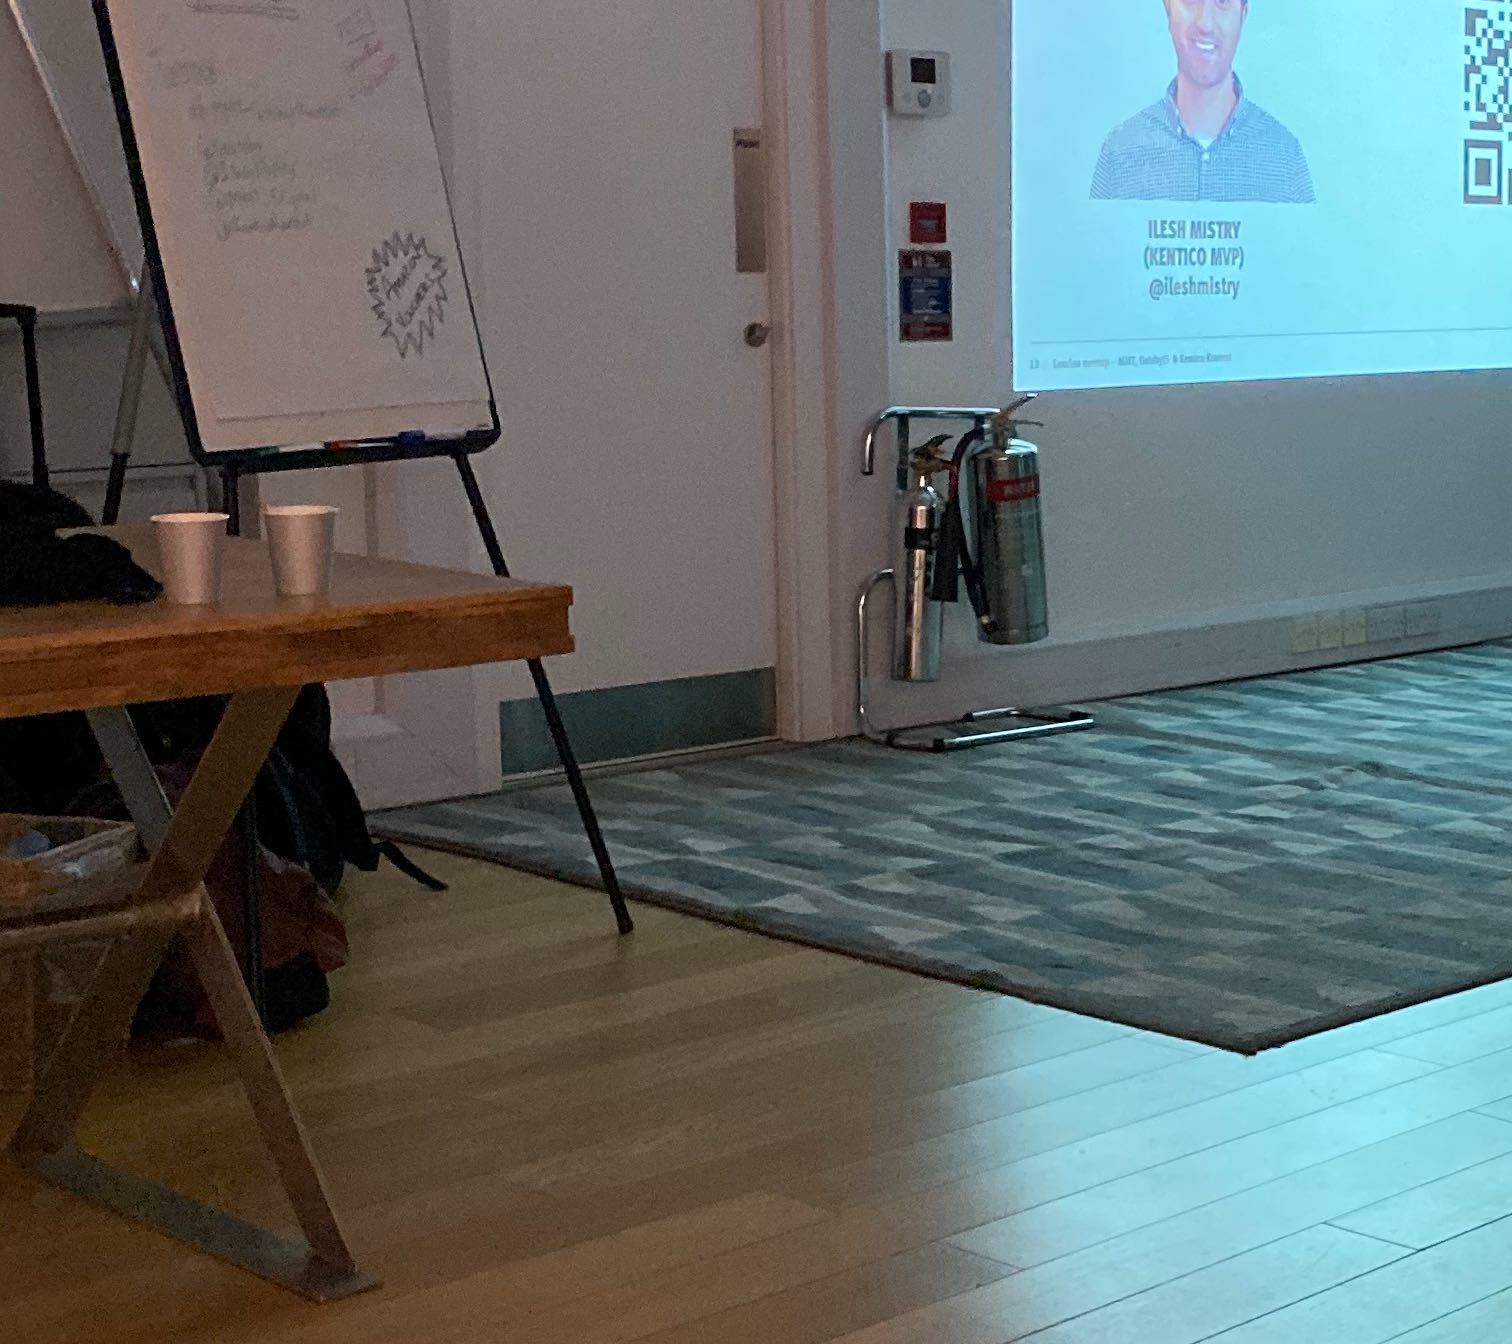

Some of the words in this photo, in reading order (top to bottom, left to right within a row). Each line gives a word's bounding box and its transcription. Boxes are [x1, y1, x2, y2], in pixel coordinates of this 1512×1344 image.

[1148, 219, 1186, 239] ILESH
[1190, 219, 1242, 239] MISTRY
[1144, 245, 1207, 270] (KENTICO
[1210, 246, 1245, 270] MVP)
[1149, 275, 1240, 301] @ileshmistry
